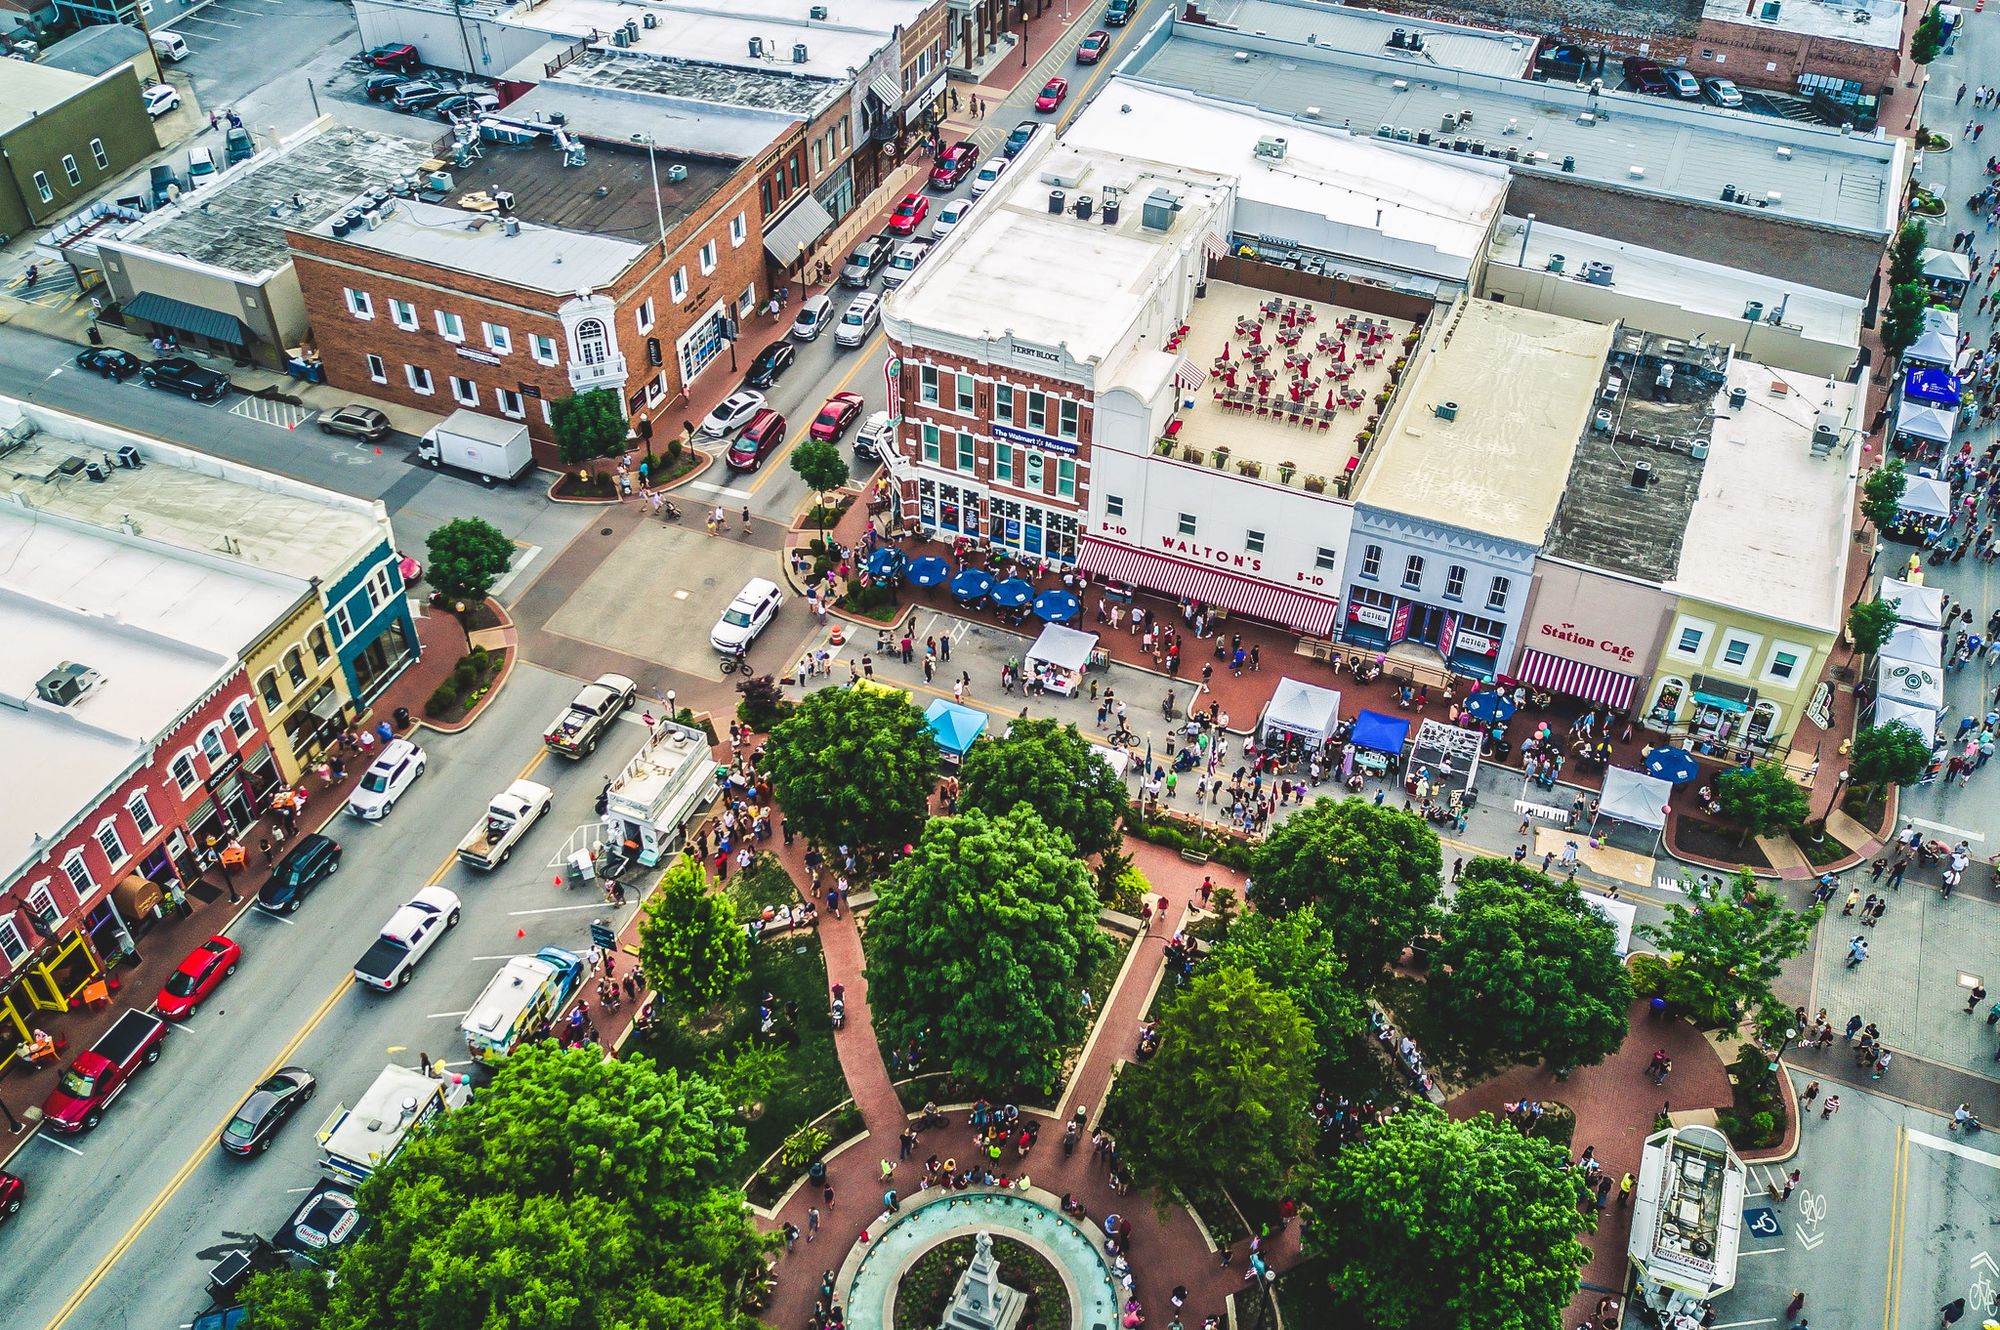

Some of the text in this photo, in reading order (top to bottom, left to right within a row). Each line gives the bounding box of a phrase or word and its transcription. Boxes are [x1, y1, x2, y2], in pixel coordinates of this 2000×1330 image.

[1012, 345, 1060, 362] TERRY BLOCK
[994, 428, 1075, 454] The Walmart Museum
[1102, 522, 1127, 536] 5-10
[1161, 535, 1262, 571] WALTON'S
[1296, 572, 1324, 586] 5-10
[1361, 610, 1387, 622] ACTION
[1460, 637, 1486, 649] ACTION
[1541, 624, 1635, 658] Station Cafe
[209, 758, 239, 787] BIOWORLD
[332, 1212, 354, 1238] Hormel
[300, 1227, 325, 1243] Hormel
[1684, 1257, 1710, 1270] FRIES
